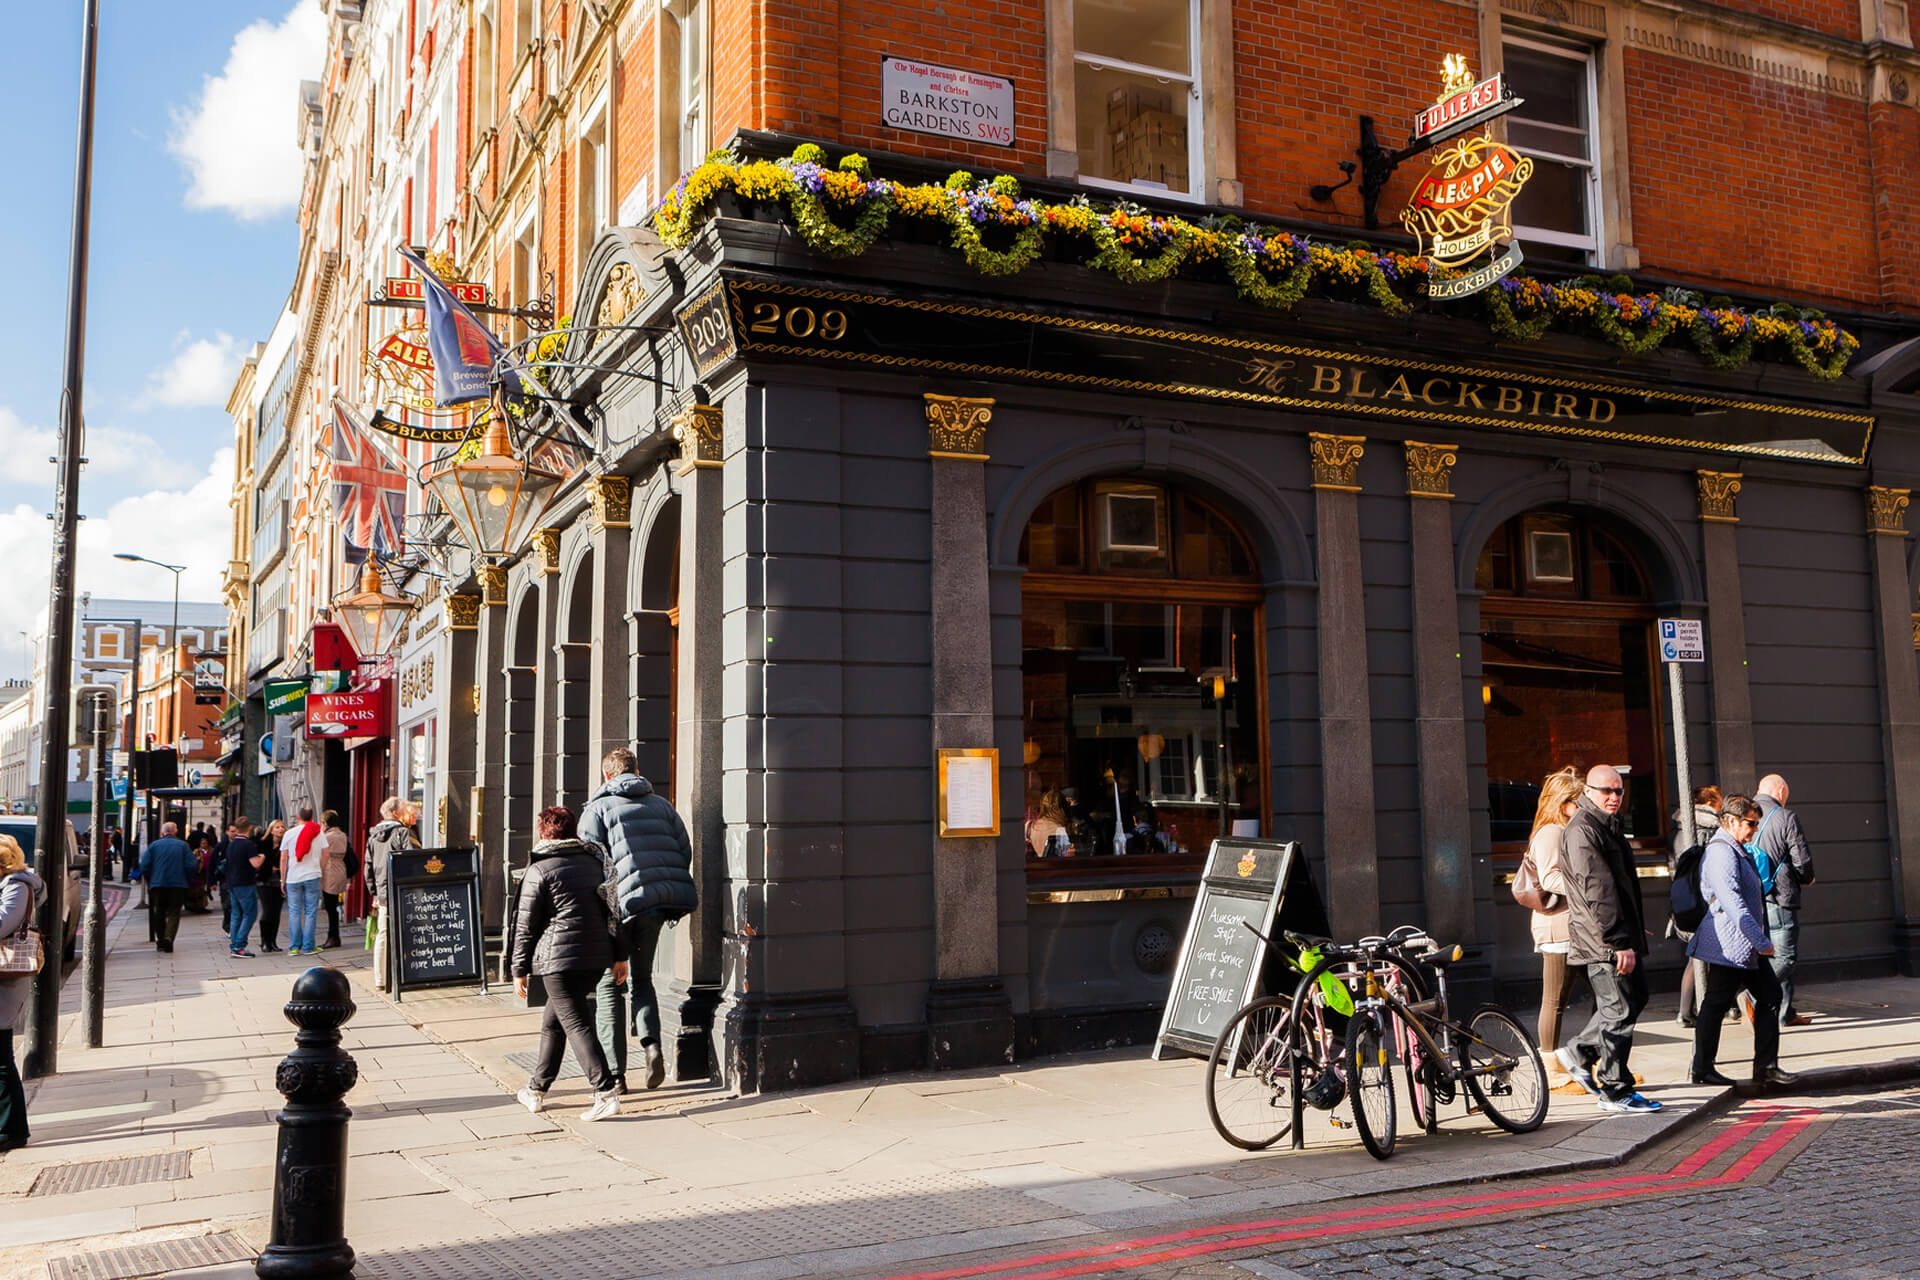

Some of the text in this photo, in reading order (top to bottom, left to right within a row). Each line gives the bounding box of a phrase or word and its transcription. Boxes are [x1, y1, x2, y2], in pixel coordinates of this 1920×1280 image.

[894, 62, 1003, 90] The Royal Borough of Kensington
[929, 83, 969, 97] and Chelsea
[899, 89, 999, 121] BARKSTON
[1418, 82, 1495, 133] FULLER'S
[1437, 231, 1486, 256] HOUSE
[1427, 256, 1513, 297] BLACKBIRD
[692, 307, 728, 356] 209
[750, 302, 848, 342] 209
[1237, 356, 1617, 424] The BLACKBIRD
[267, 686, 309, 710] SUBWAY
[321, 695, 364, 706] WINES
[311, 709, 375, 721] & CIGARS
[405, 892, 418, 905] It
[414, 903, 440, 913] matter
[440, 910, 460, 921] half
[448, 919, 465, 931] half
[1207, 906, 1247, 926] Awesome
[453, 943, 467, 954] for
[1187, 977, 1235, 1004] FREE SMILE
